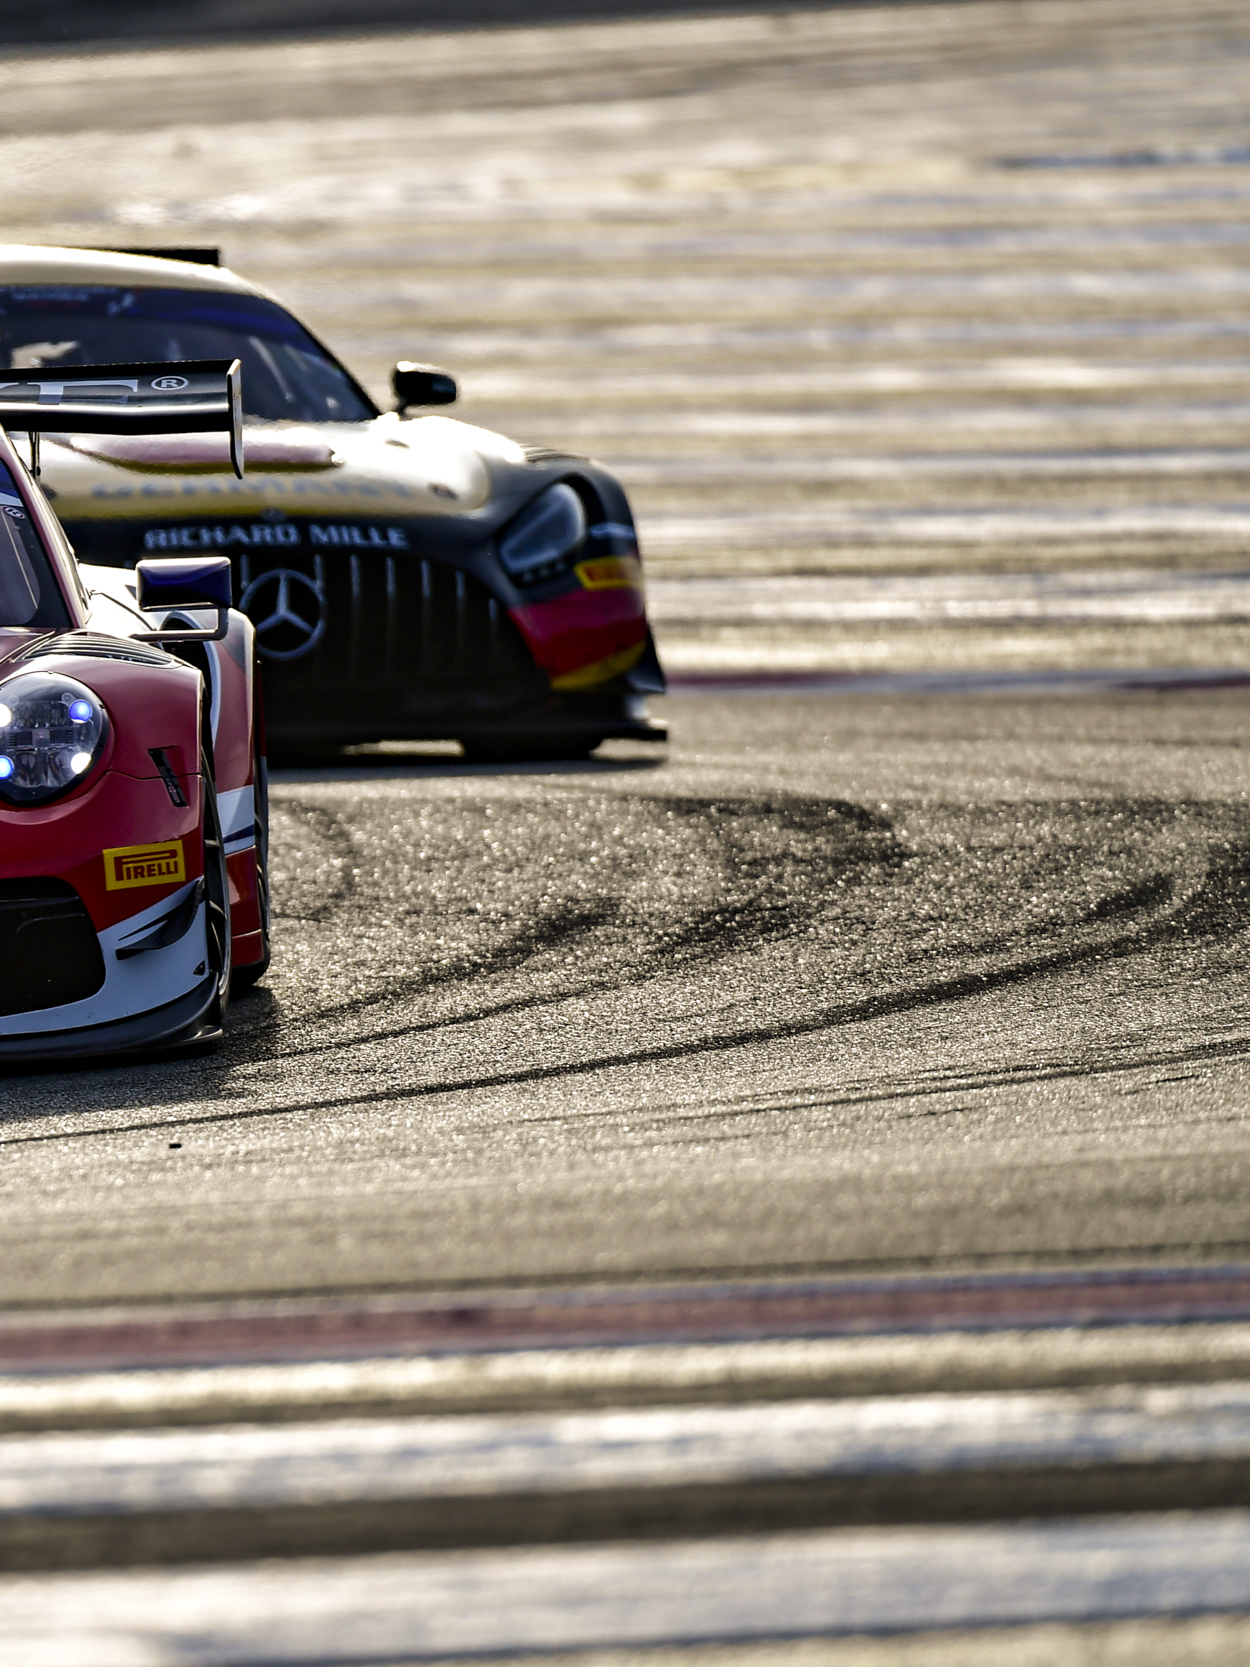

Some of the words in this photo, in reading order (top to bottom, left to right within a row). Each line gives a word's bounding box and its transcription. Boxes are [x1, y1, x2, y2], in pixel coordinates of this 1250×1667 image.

[144, 524, 301, 549] RICHARD
[309, 524, 408, 549] MILLE
[113, 849, 179, 881] PIRELLI
